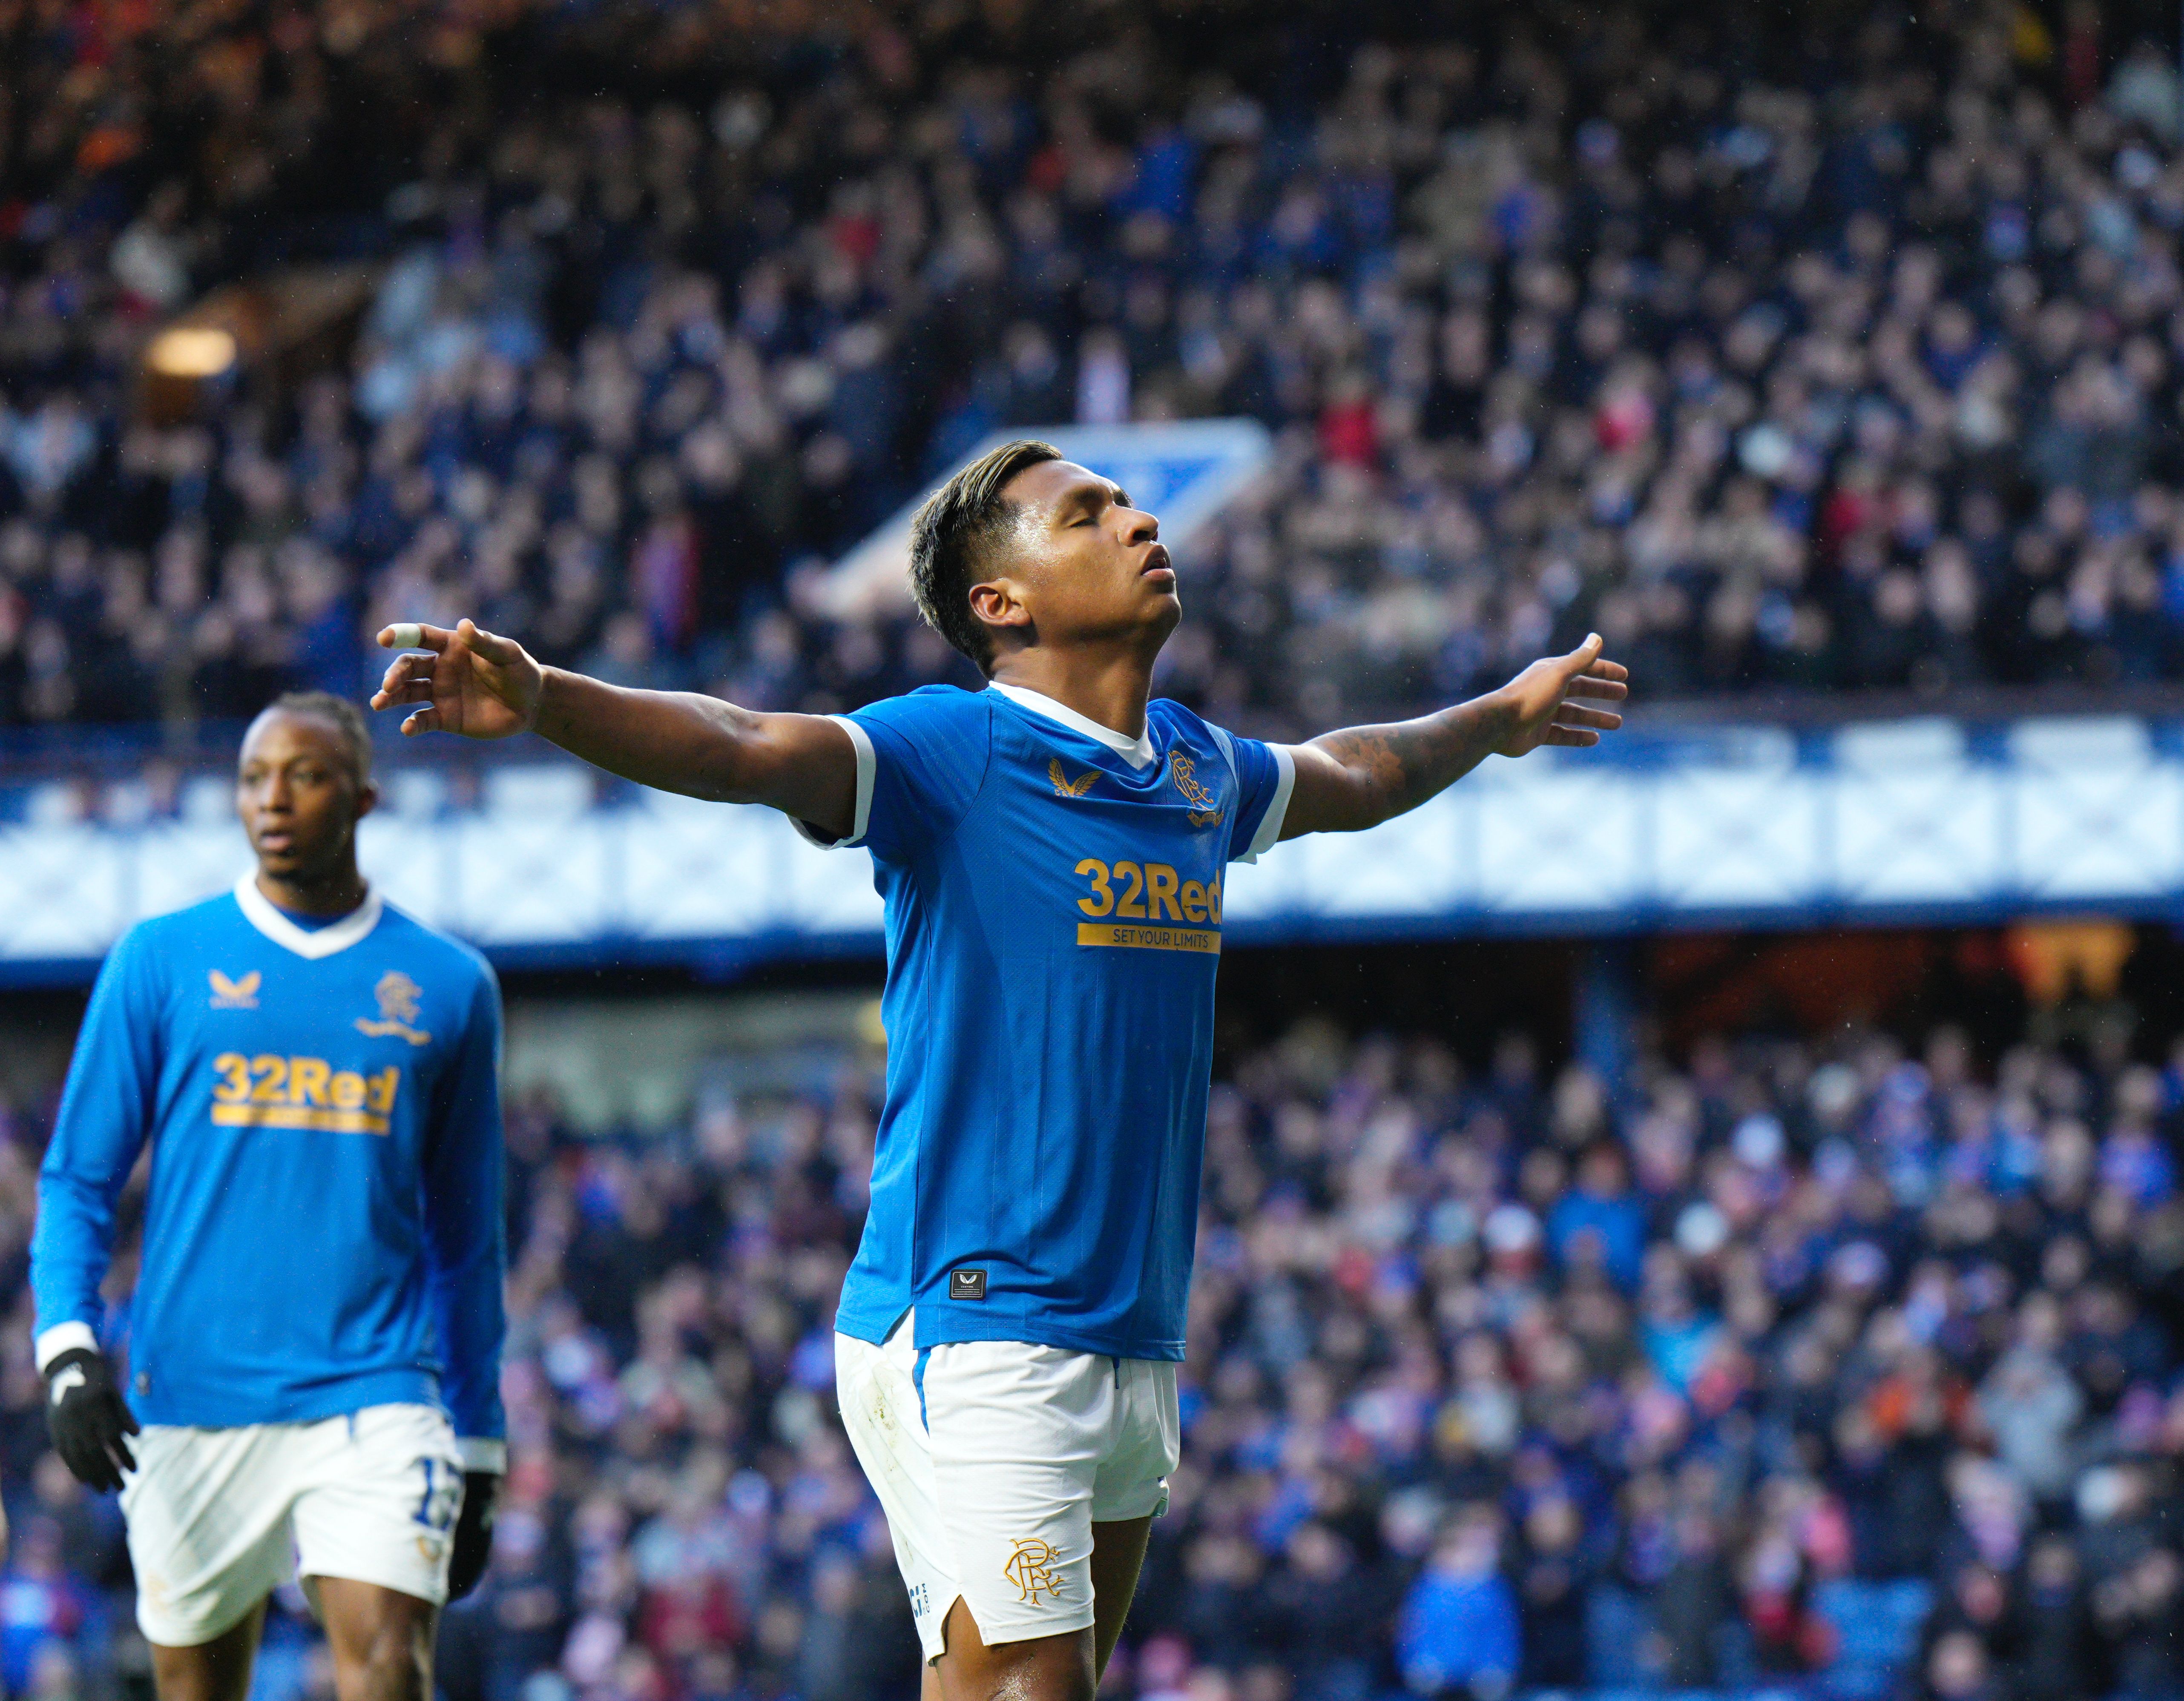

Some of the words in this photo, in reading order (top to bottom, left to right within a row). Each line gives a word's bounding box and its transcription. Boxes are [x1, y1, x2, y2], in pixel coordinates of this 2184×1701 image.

[1074, 858, 1222, 925] 32Red
[1113, 928, 1135, 943] SET
[1138, 930, 1170, 945] YOUR
[1174, 932, 1209, 948] LIMITS
[214, 1052, 400, 1113] 32Red
